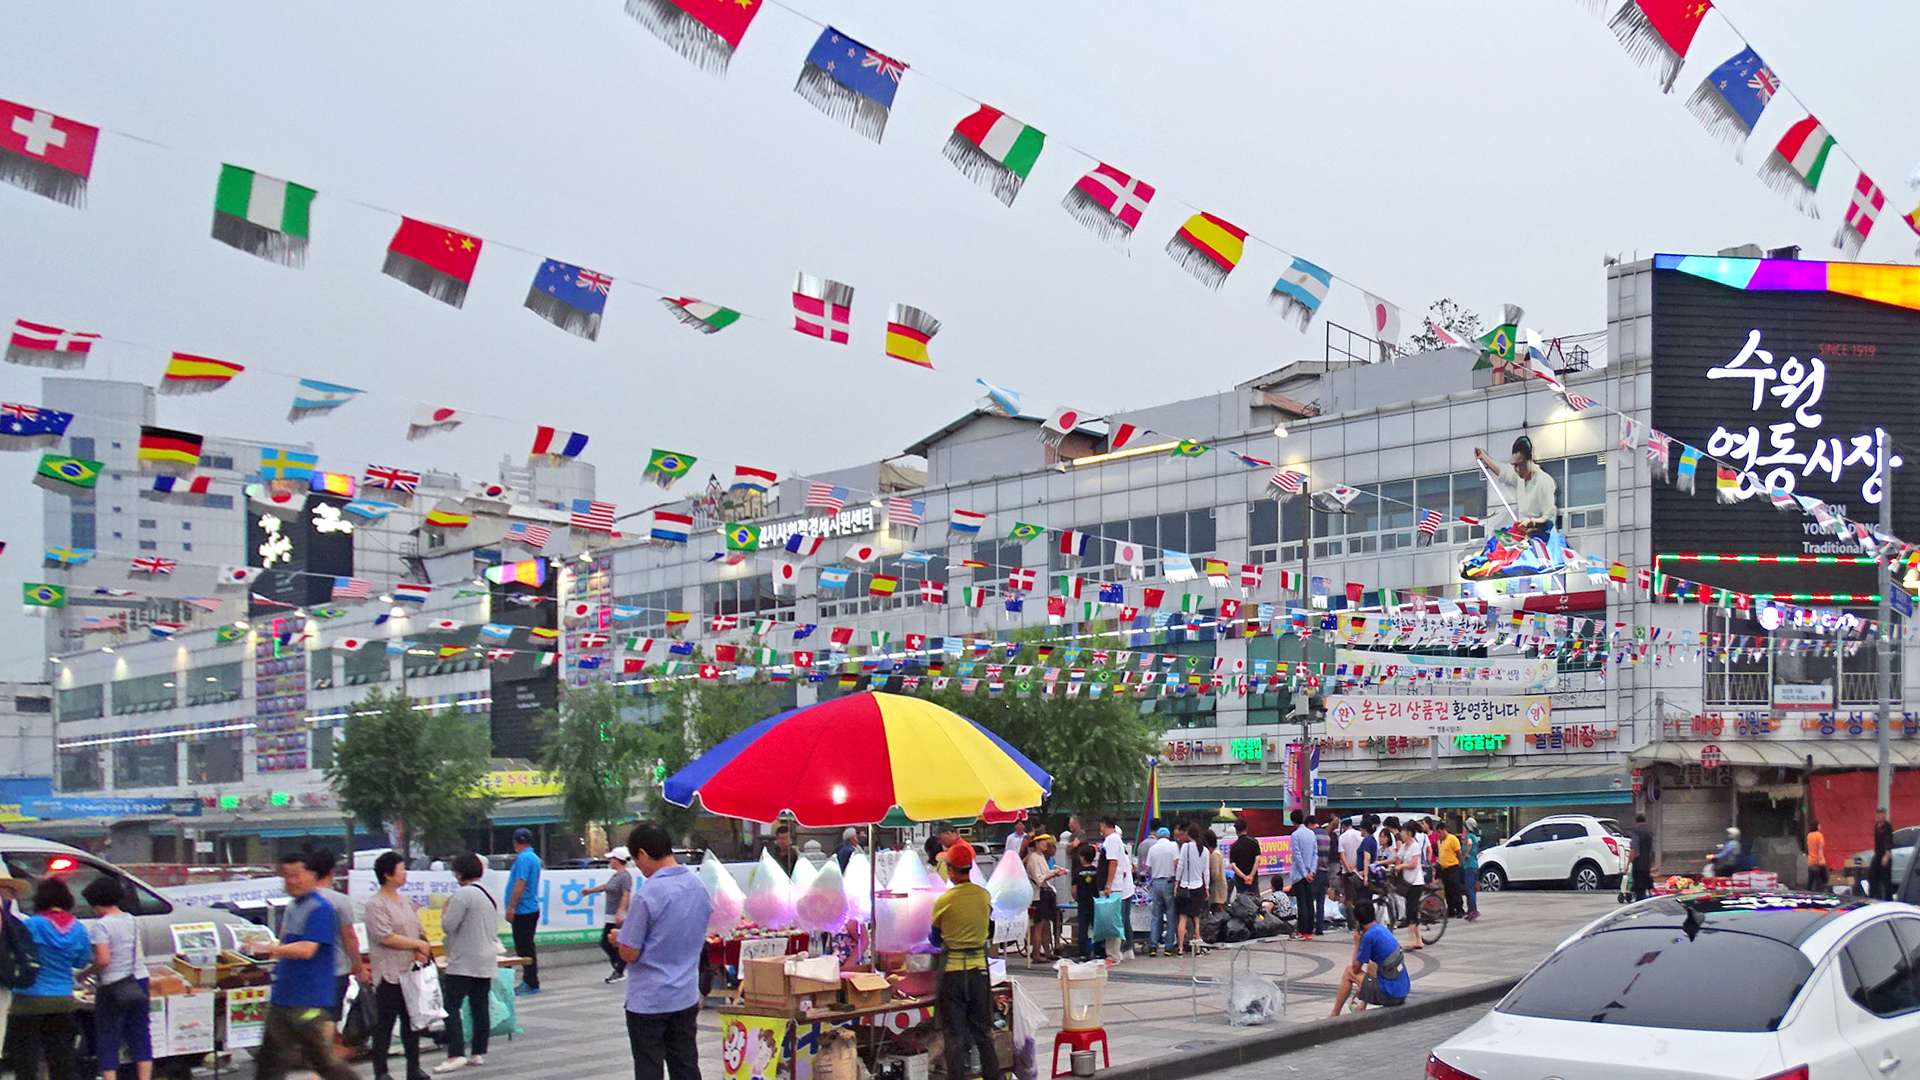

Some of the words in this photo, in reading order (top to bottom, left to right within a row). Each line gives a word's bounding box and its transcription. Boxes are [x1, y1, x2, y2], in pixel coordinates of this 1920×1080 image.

[1851, 344, 1877, 357] 1919
[1706, 329, 1826, 429] 수원
[1706, 422, 1903, 504] 영동시장
[1802, 541, 1863, 554] Traditional
[1361, 699, 1402, 721] 온누리
[1406, 699, 1449, 721] 상품권
[1452, 699, 1520, 721] 환영합니다
[1663, 710, 1724, 737] 알뜰매장
